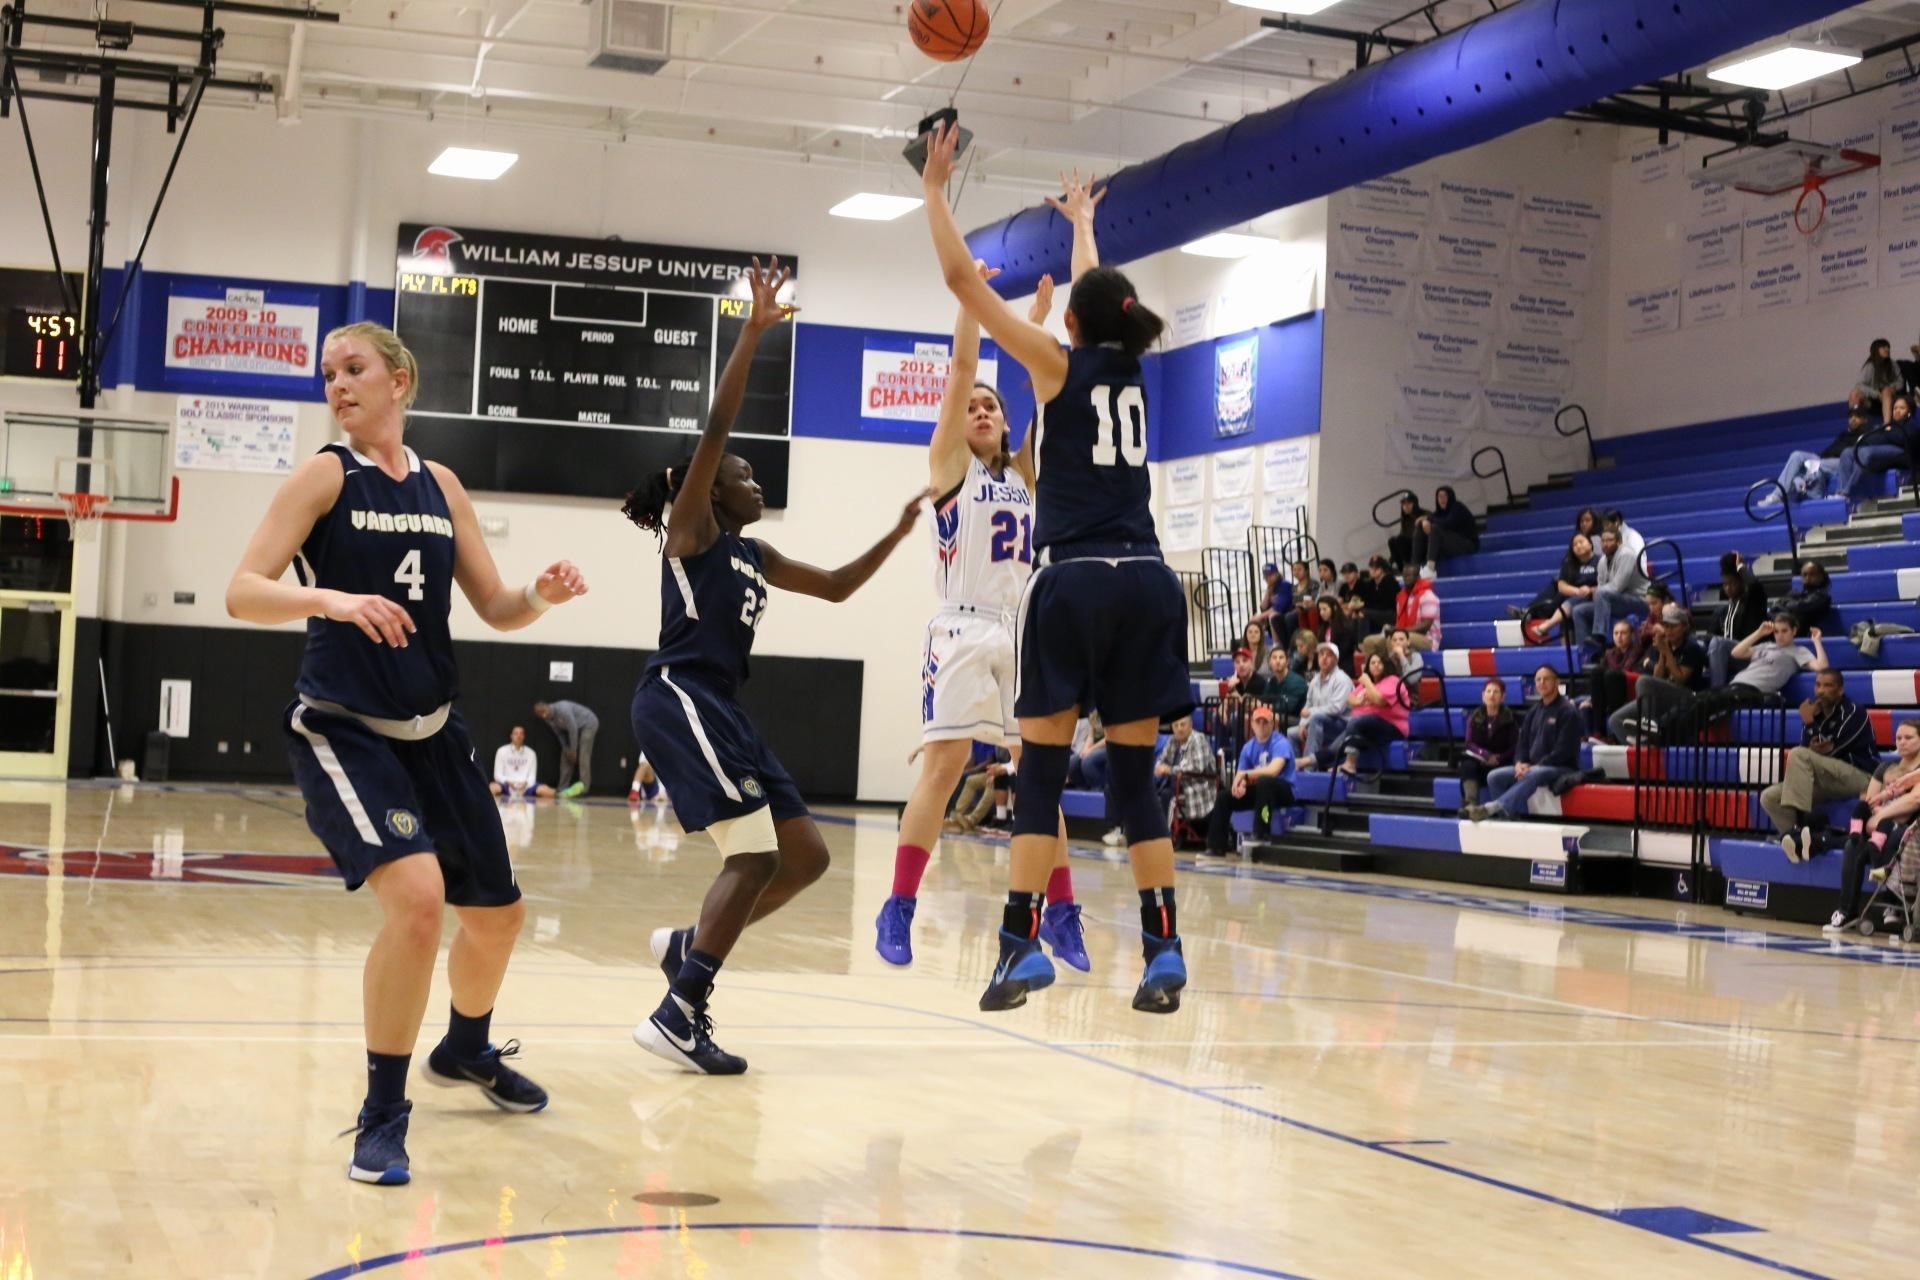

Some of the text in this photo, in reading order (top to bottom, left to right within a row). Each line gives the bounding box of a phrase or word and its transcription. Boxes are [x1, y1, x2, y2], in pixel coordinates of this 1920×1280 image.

[1400, 187, 1429, 199] Church
[1463, 196, 1492, 207] Church
[1340, 223, 1419, 240] Harvest Community
[1365, 235, 1395, 247] Church
[461, 243, 560, 268] WILLIAM
[565, 251, 652, 276] JESSUP
[1453, 246, 1482, 258] Church
[1538, 256, 1567, 267] Church
[401, 273, 477, 296] PLY FL PTS
[1370, 274, 1407, 287] Christian
[720, 299, 744, 317] PLY
[1425, 293, 1491, 308] Christian Church
[1546, 306, 1575, 318] Church
[28, 315, 76, 337] 4:57
[183, 319, 303, 340] CONFERENCE
[498, 317, 698, 347] HOME GUEST
[581, 330, 615, 344] PERIOD
[174, 334, 309, 368] CHAMPIONS
[1433, 342, 1462, 354] Church
[1542, 355, 1570, 366] Church
[489, 366, 520, 380] FOULS
[563, 371, 599, 386] PLAYER
[603, 374, 627, 388] FOUL
[670, 378, 700, 392] FOULS
[877, 372, 948, 388] CONFERE
[869, 386, 943, 410] CHAMP
[1403, 386, 1419, 396] The
[1442, 389, 1472, 401] Church
[205, 409, 244, 421] CLASSIC
[245, 413, 294, 424] SPONSORS
[487, 404, 698, 430] SCORE MATCH SCORE
[1090, 384, 1148, 467] 10
[973, 483, 1031, 507] JESSU
[351, 509, 454, 539] VANGUARD
[991, 510, 1031, 566] 21
[394, 549, 425, 601] 4
